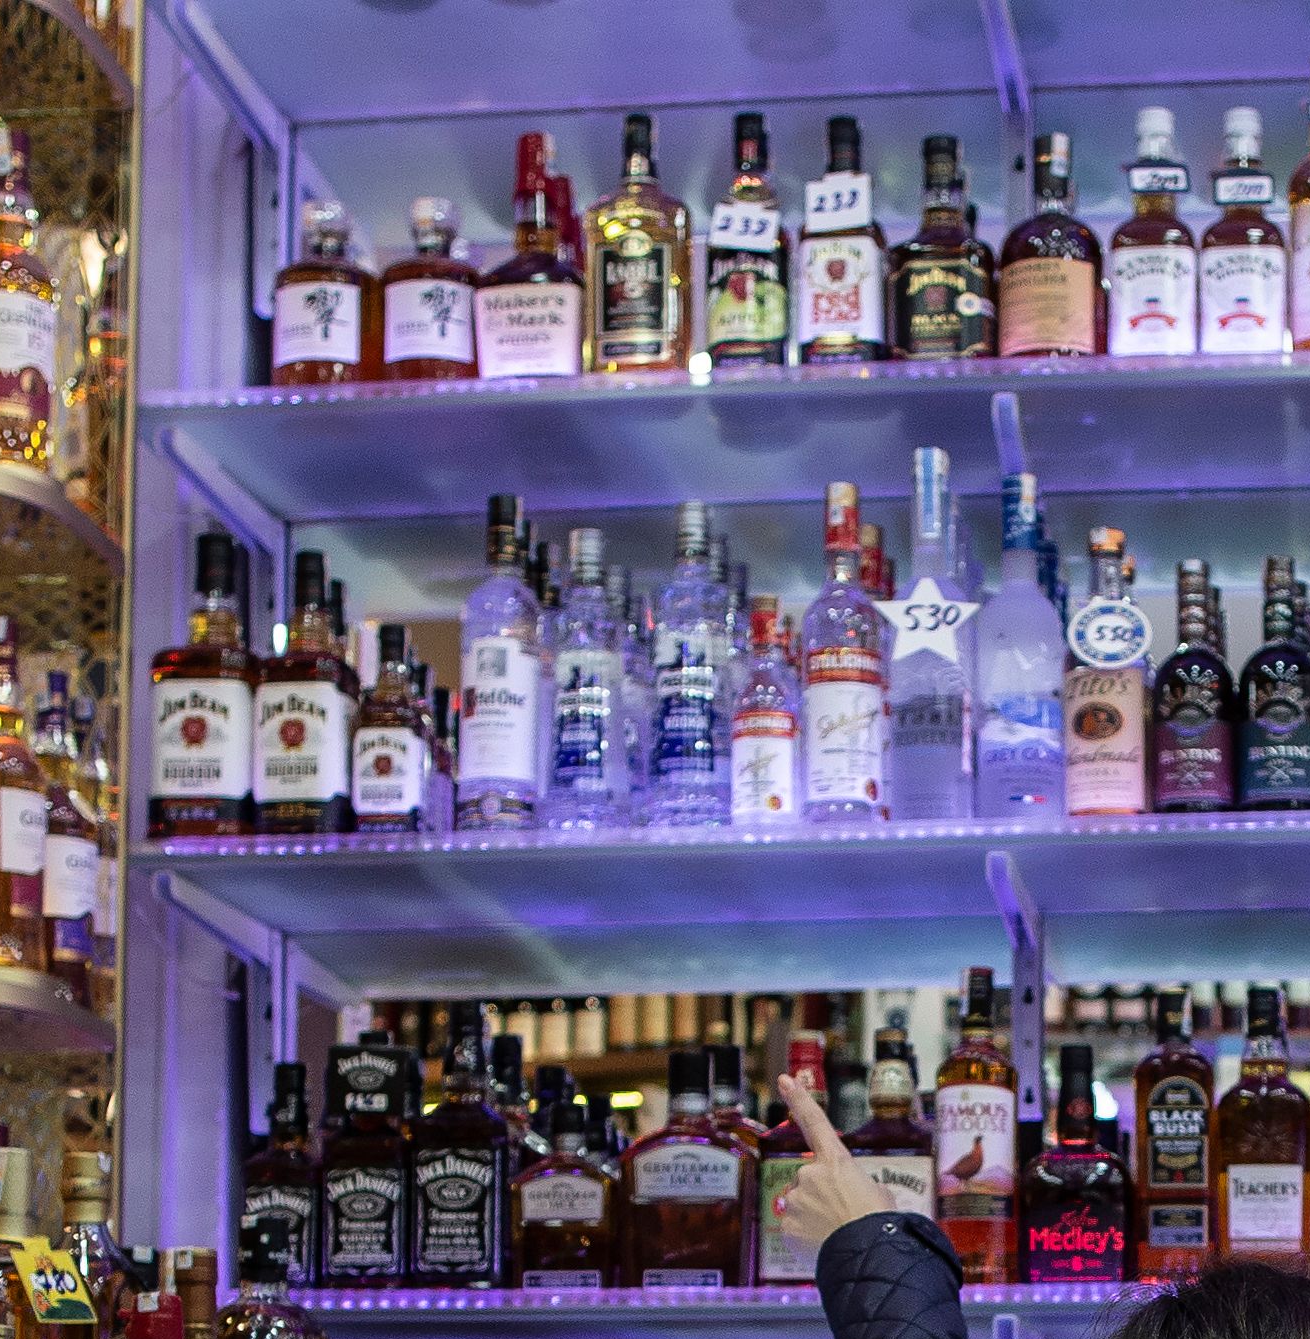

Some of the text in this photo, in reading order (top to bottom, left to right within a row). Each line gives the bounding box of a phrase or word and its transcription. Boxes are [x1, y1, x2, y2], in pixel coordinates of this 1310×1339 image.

[905, 603, 960, 632] 530
[159, 690, 230, 722] JIM BEAM
[260, 692, 327, 723] JIM BEAM
[1148, 1108, 1204, 1123] BLACK
[1233, 1177, 1301, 1199] TEACHER'S
[1029, 1225, 1126, 1254] Medley's
